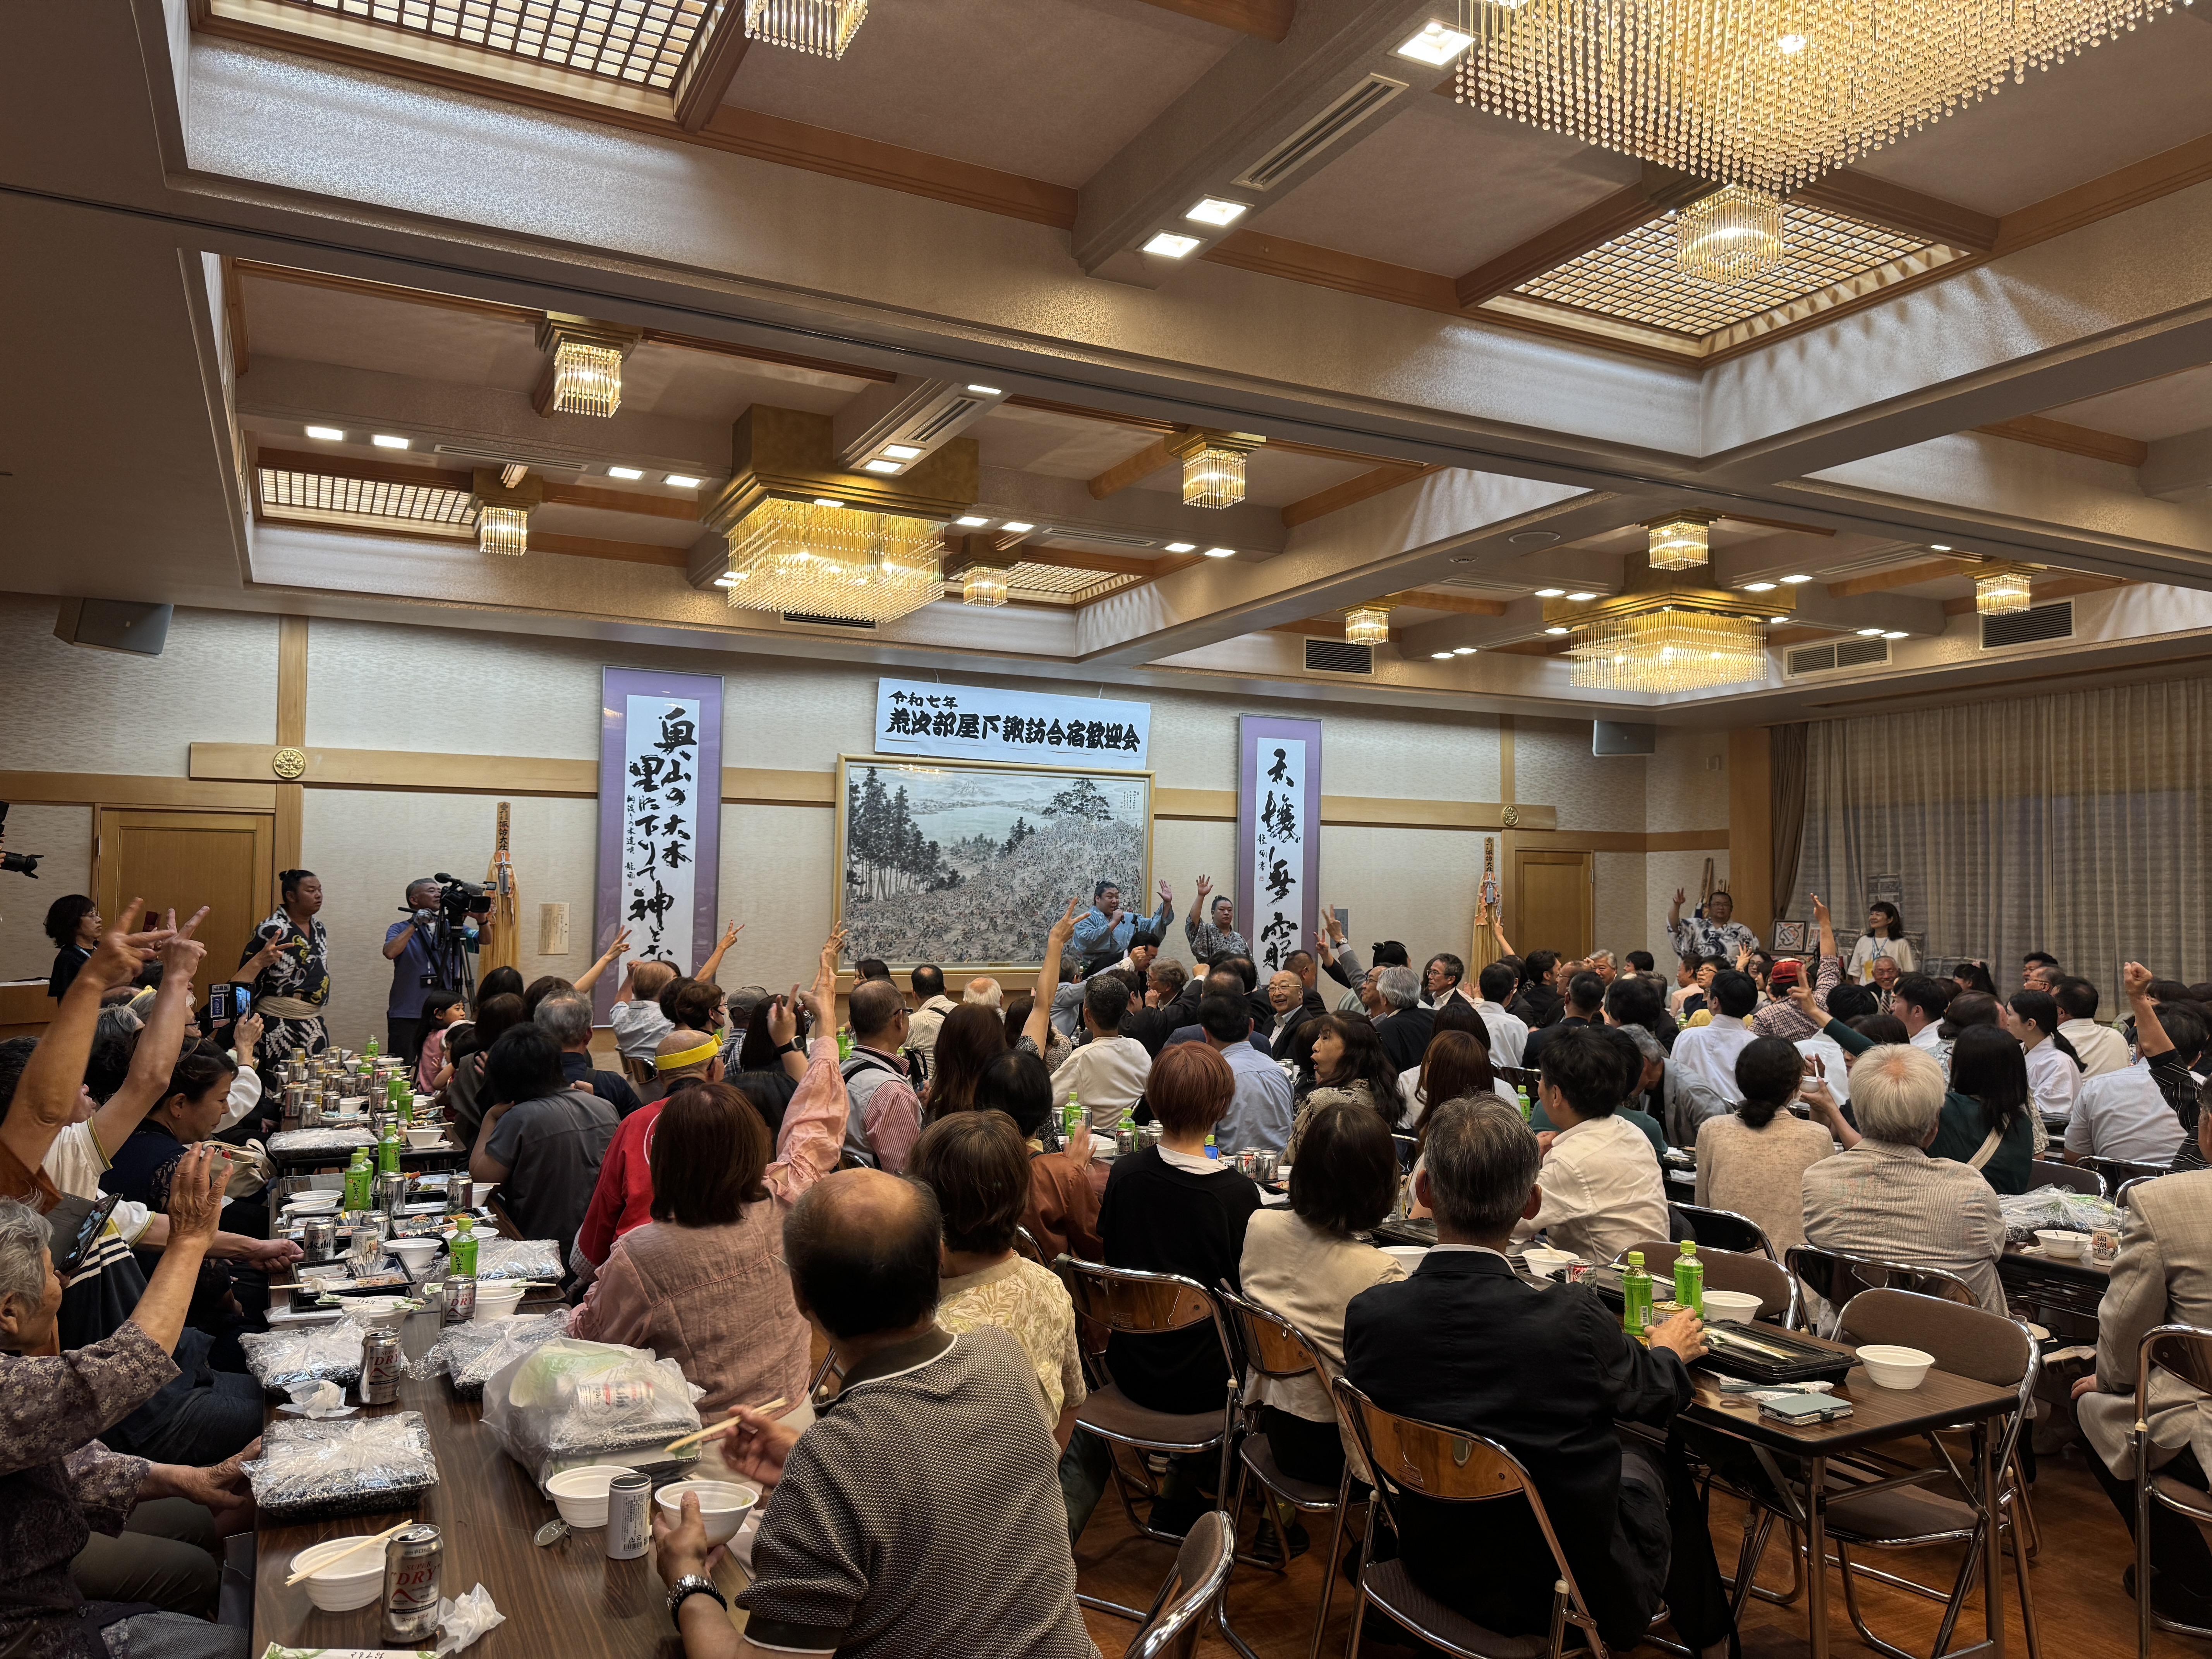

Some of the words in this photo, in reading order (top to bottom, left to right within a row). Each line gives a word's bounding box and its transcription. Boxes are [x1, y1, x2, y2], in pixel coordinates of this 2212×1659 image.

[888, 690, 958, 709] 令和七年
[306, 1238, 331, 1250] Asahi
[407, 1561, 432, 1570] SUPER
